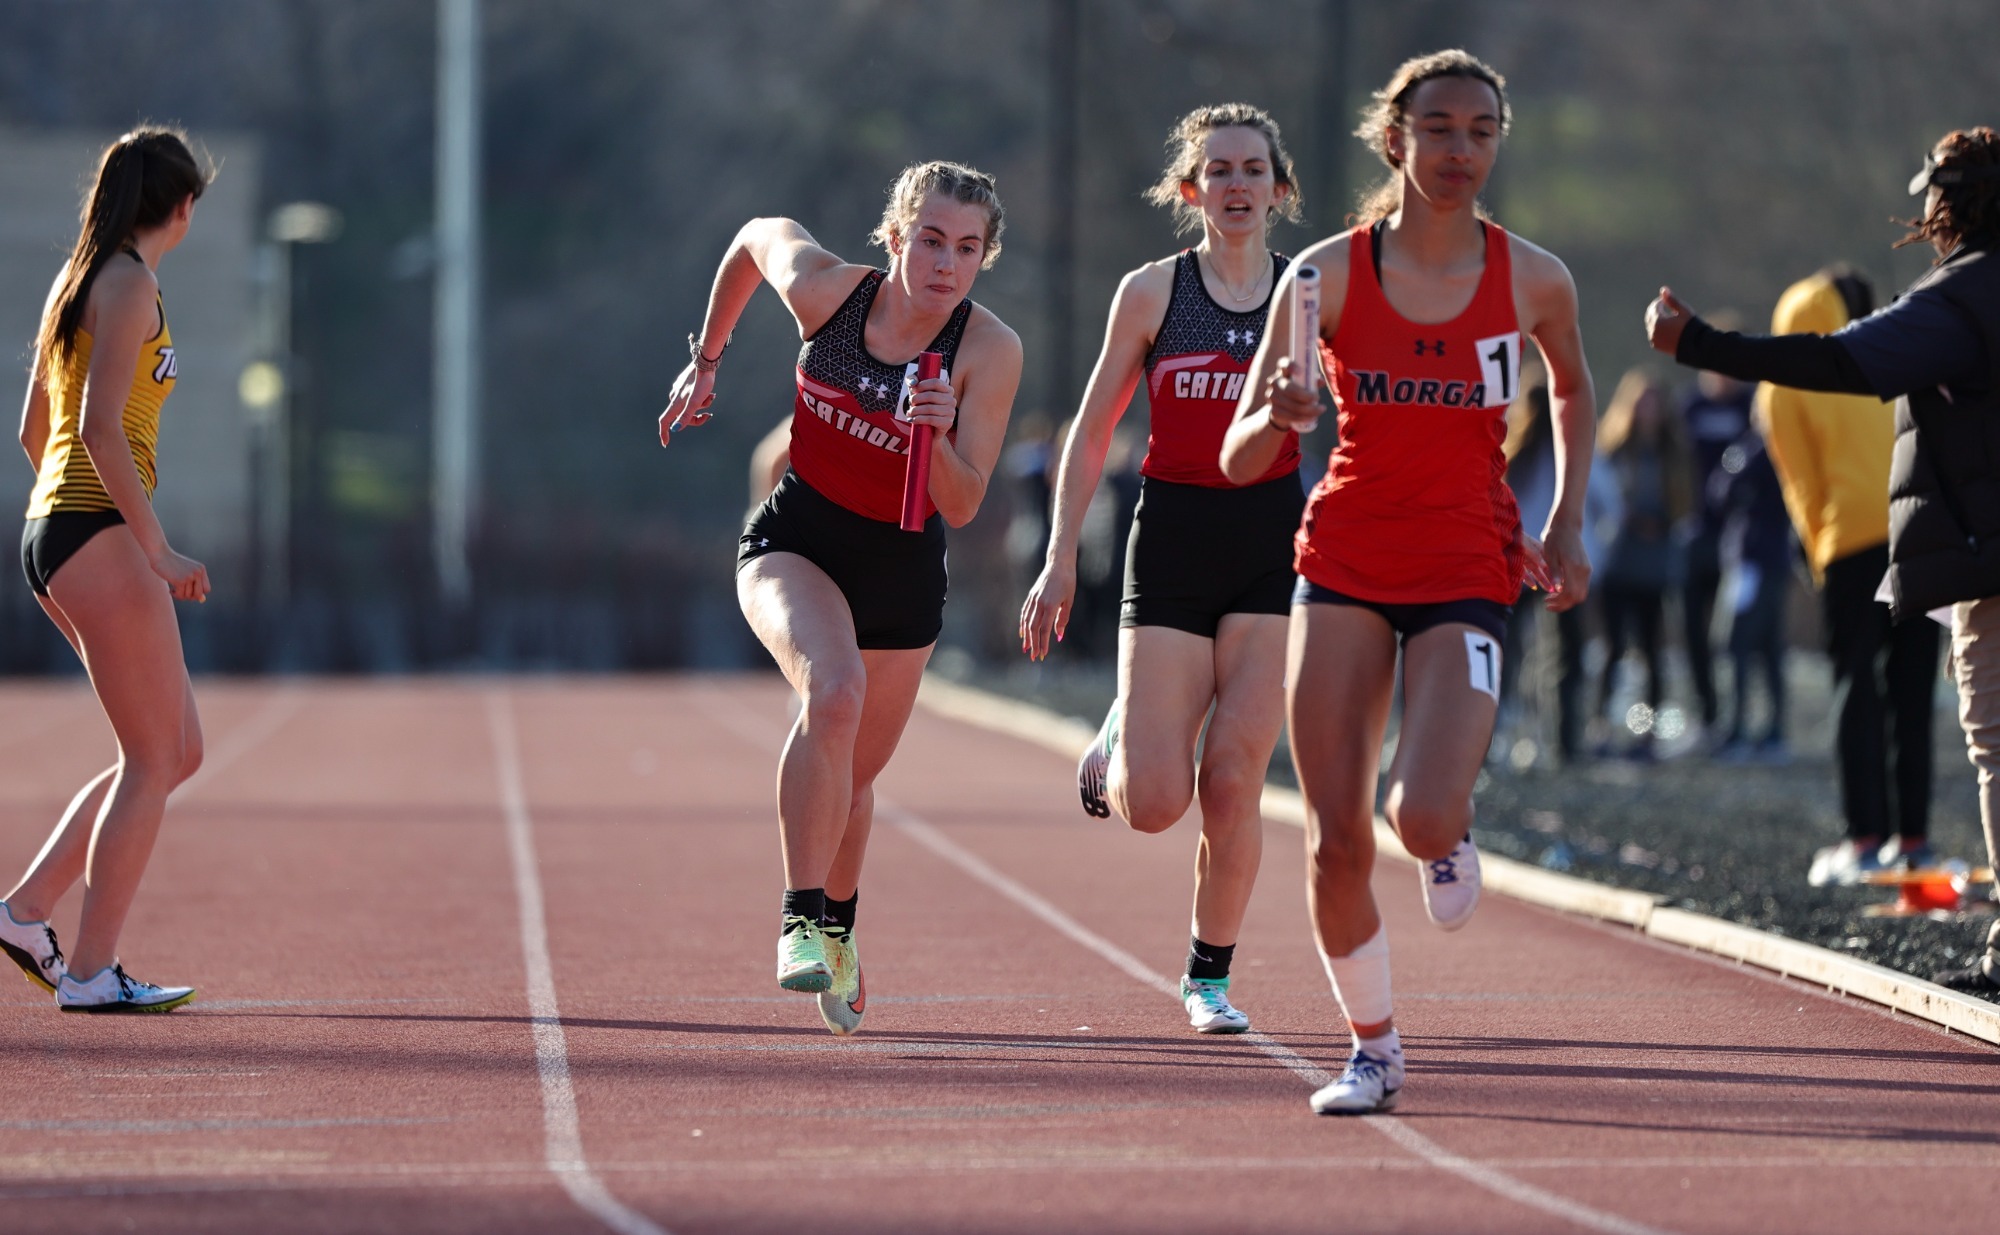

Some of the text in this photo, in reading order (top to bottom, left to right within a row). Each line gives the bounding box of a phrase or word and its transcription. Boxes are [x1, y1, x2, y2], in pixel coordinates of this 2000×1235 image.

[1488, 341, 1510, 399] 1
[802, 390, 912, 455] CATHOL
[1475, 642, 1492, 690] 1
